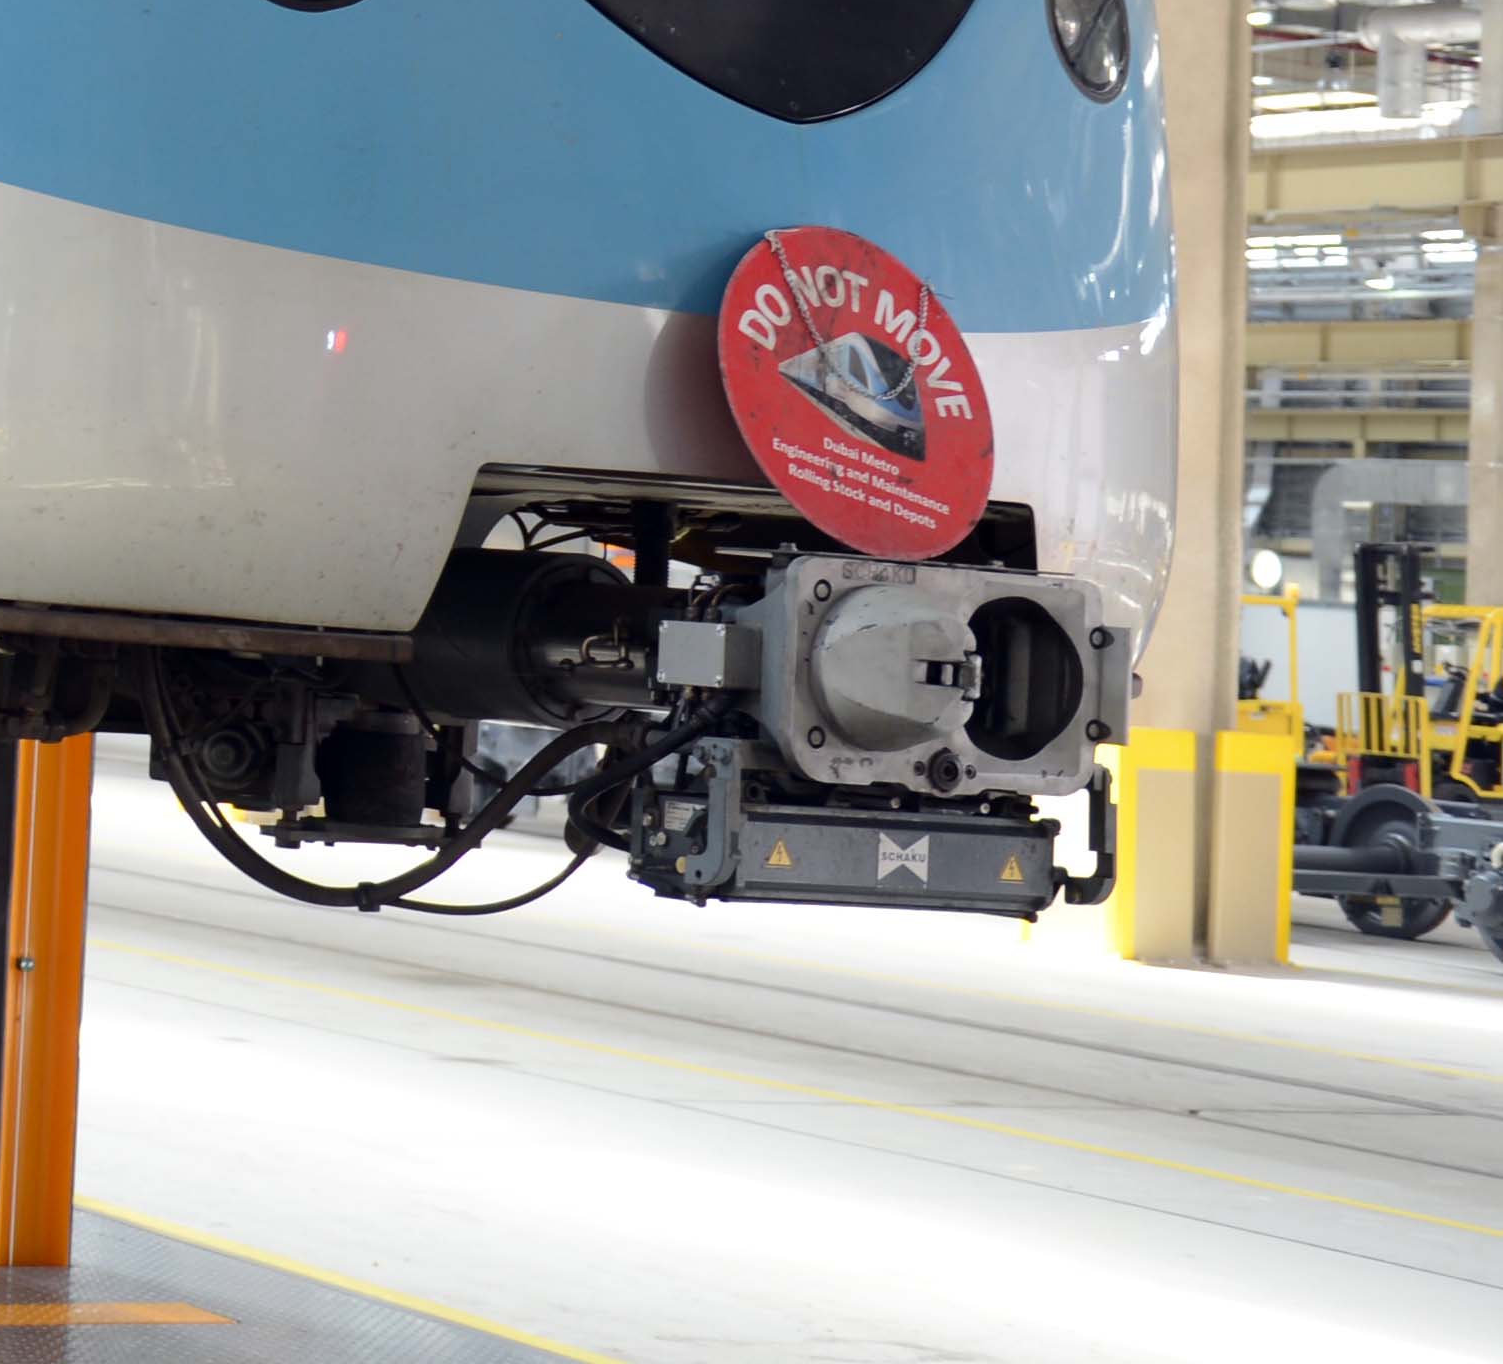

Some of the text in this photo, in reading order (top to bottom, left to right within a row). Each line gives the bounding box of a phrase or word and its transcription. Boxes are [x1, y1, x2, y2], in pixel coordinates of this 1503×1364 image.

[738, 264, 974, 421] DO NOT MOVE
[772, 437, 951, 516] Engineering and Maintenance
[823, 437, 901, 476] Dubai Metro
[788, 464, 937, 530] Rolling Stock and Depots
[881, 851, 927, 863] SCHAKU
